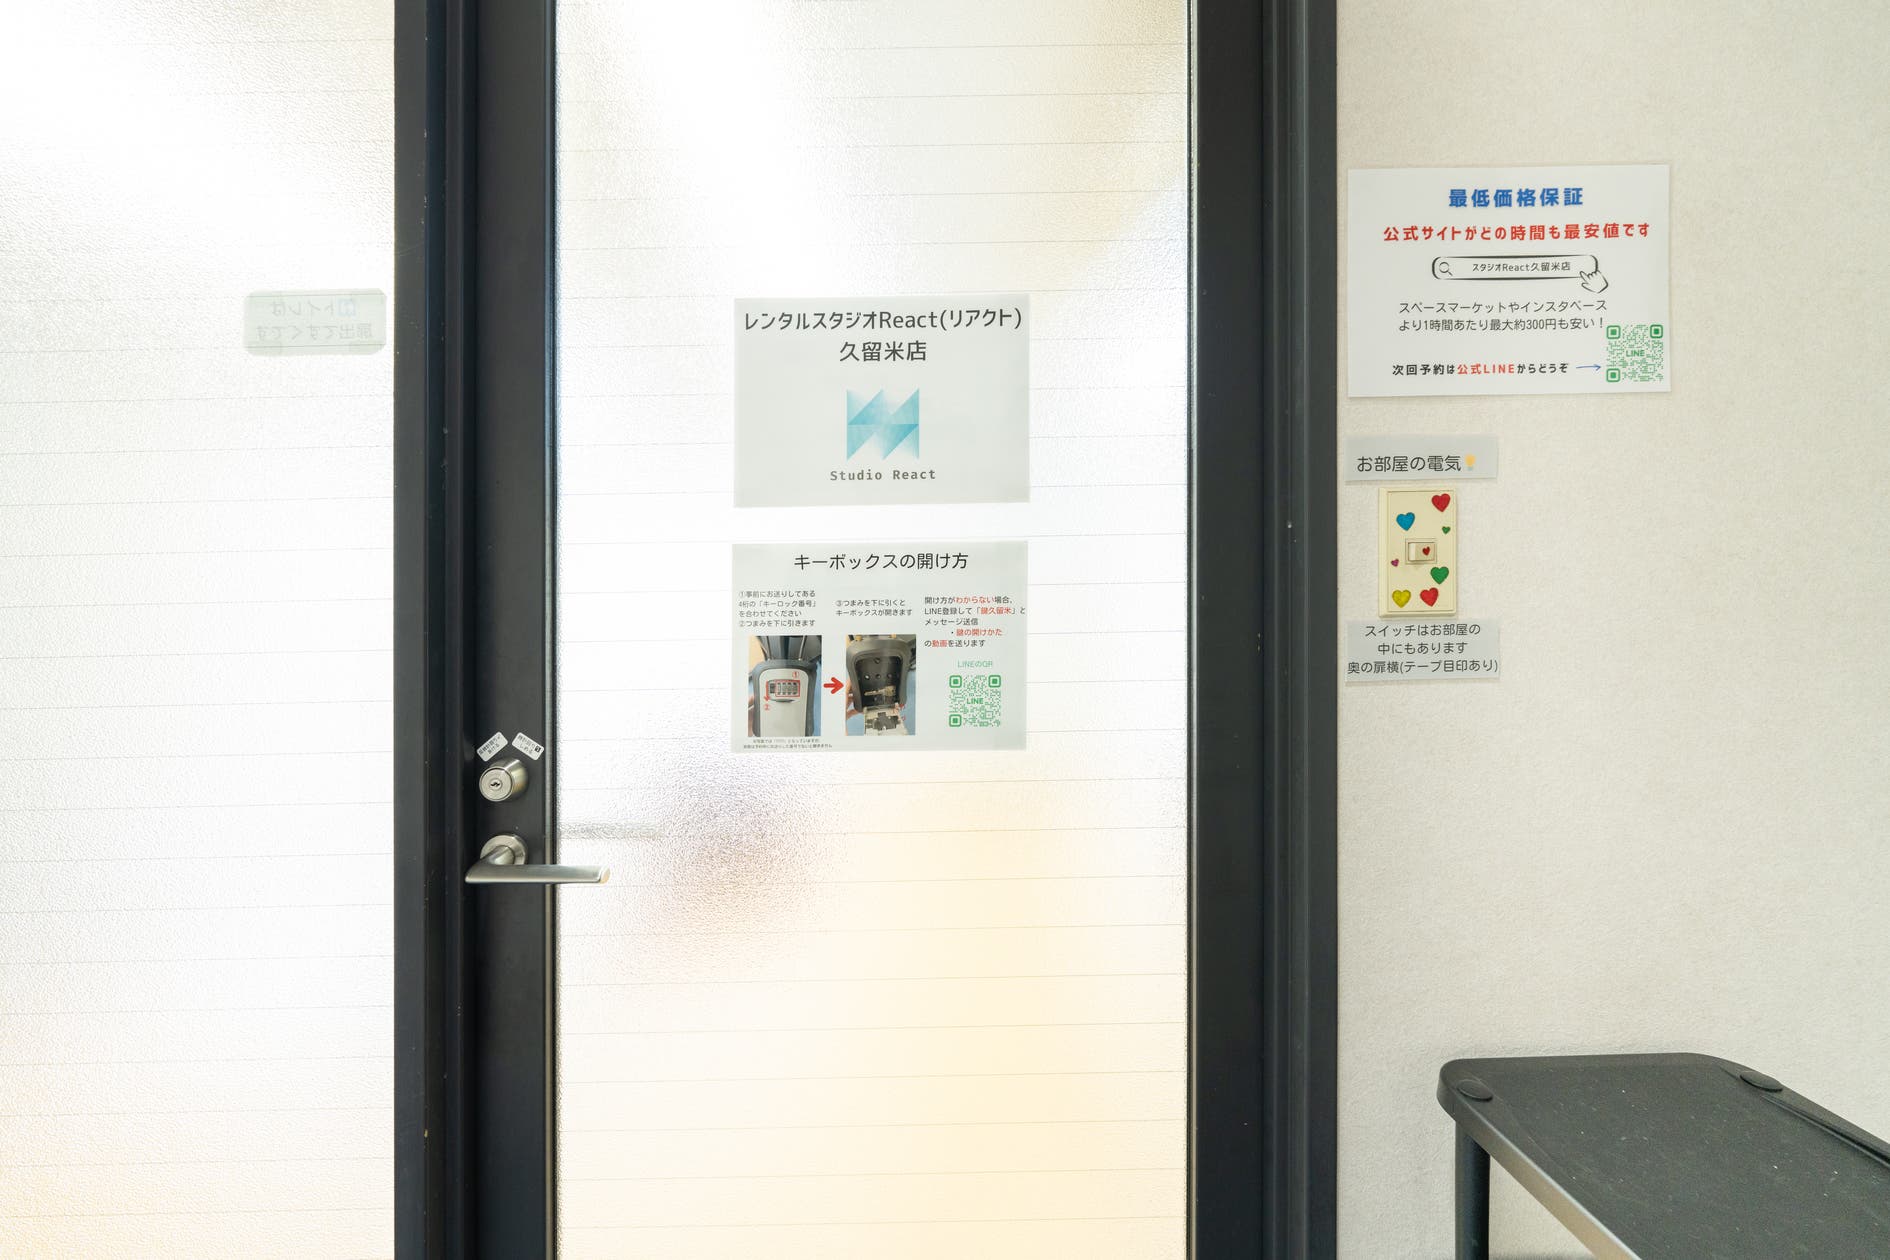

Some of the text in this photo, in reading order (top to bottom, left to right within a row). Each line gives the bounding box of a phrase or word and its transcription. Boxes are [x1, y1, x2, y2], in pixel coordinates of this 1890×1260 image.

[1449, 187, 1584, 208] 最低価格保証
[1383, 222, 1650, 242] 公式サイトがどの時間も最安値です
[1472, 261, 1571, 272] スタジオReact久留米店
[1399, 299, 1608, 314] スペースマーケットやインスタベース
[744, 307, 1022, 331] レンタルスタジオReact(リアクト)
[839, 340, 927, 362] 久留米店
[1626, 349, 1645, 358] LINE
[1392, 363, 1569, 376] 次回予約は公式LINEからどうぞ
[1357, 455, 1461, 473] お部屋の電気
[830, 469, 936, 481] Studio React
[794, 553, 969, 570] キーボックスの開け方
[1365, 624, 1481, 638] スイッチはお部屋の
[1377, 642, 1468, 655] 中にもあります
[1347, 659, 1498, 675] 奥の扉横(テープ目印あり)
[966, 697, 984, 705] LINE
